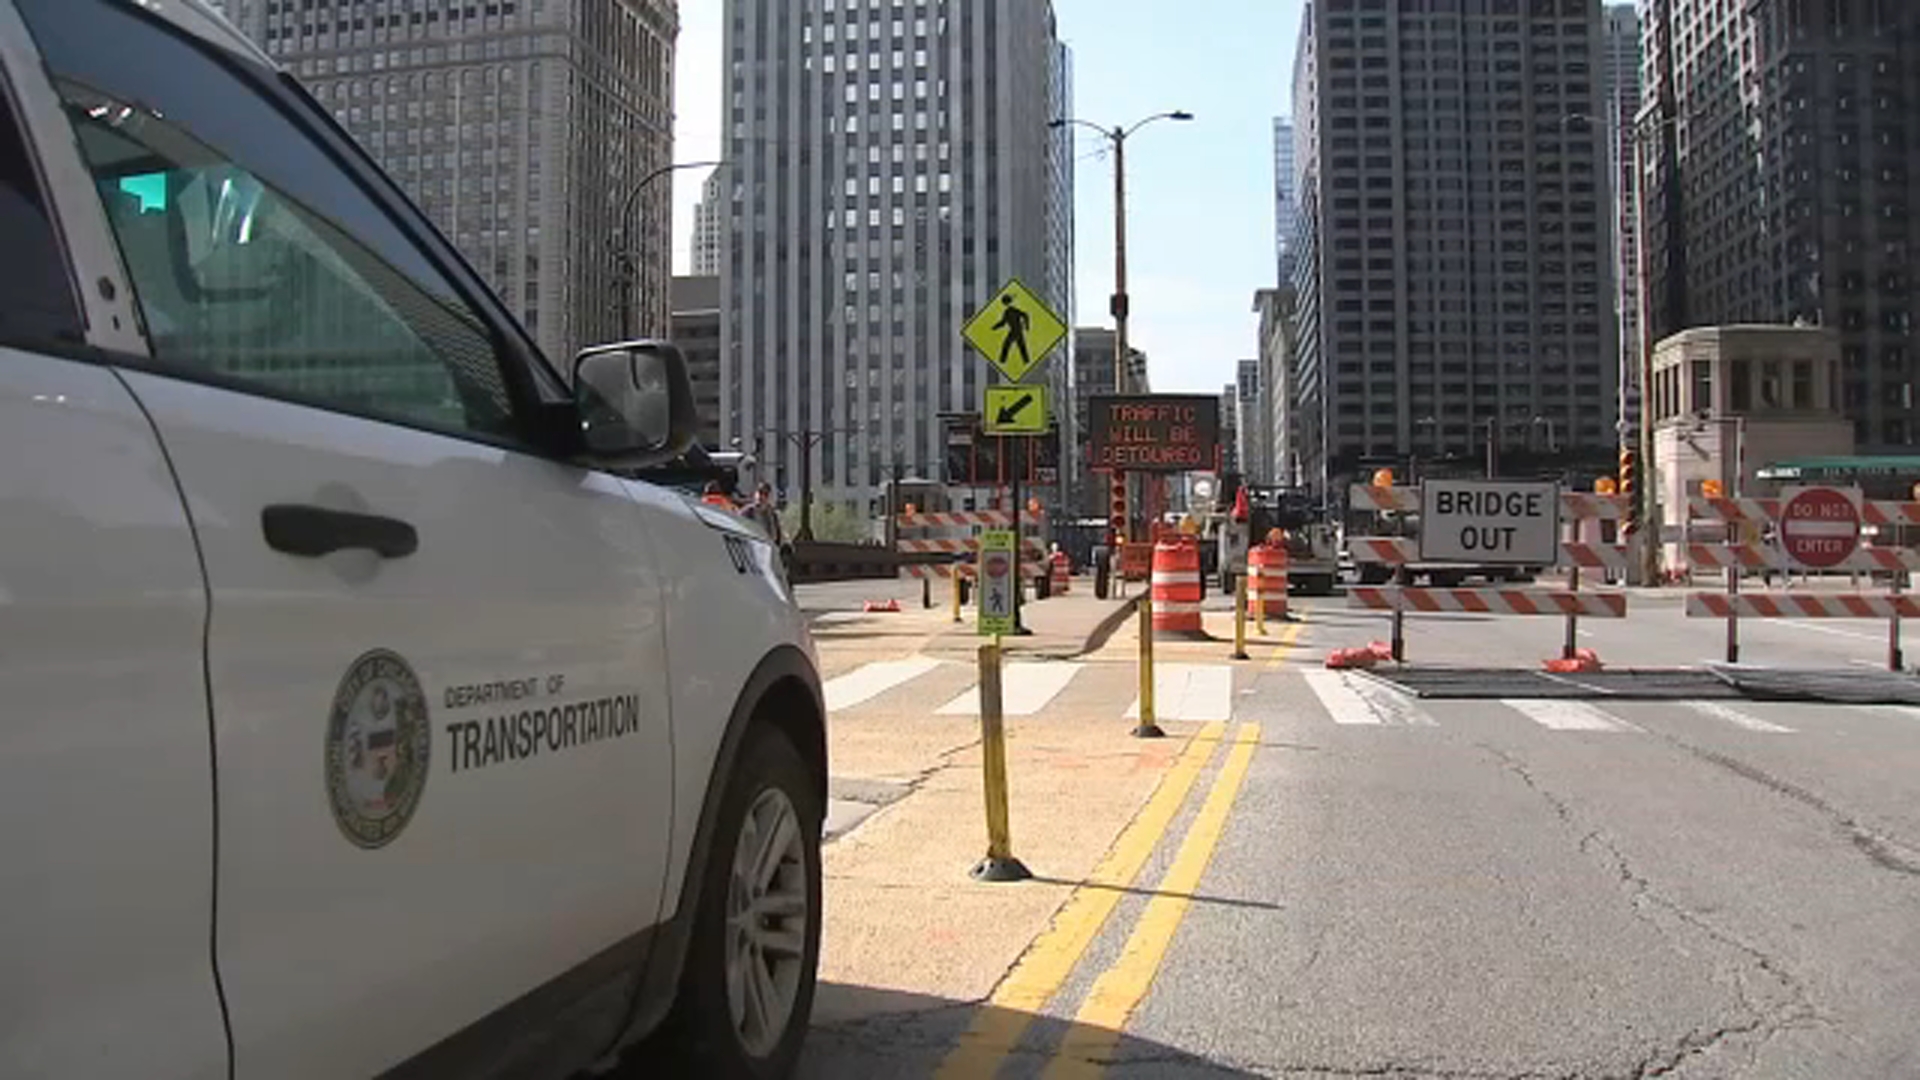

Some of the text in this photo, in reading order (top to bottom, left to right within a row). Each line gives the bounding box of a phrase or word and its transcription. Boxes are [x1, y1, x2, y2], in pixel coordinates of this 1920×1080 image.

[1109, 404, 1195, 421] TRAFFIC
[1109, 426, 1196, 442] WILL BE
[1102, 446, 1200, 463] DETOURED
[1436, 491, 1542, 517] BRIDGE
[1793, 503, 1813, 517] DO
[1460, 526, 1517, 551] OUT
[1796, 539, 1843, 553] ENTER
[444, 674, 565, 709] DEPARTMENT OF
[446, 694, 640, 774] TRANSPORTATION
